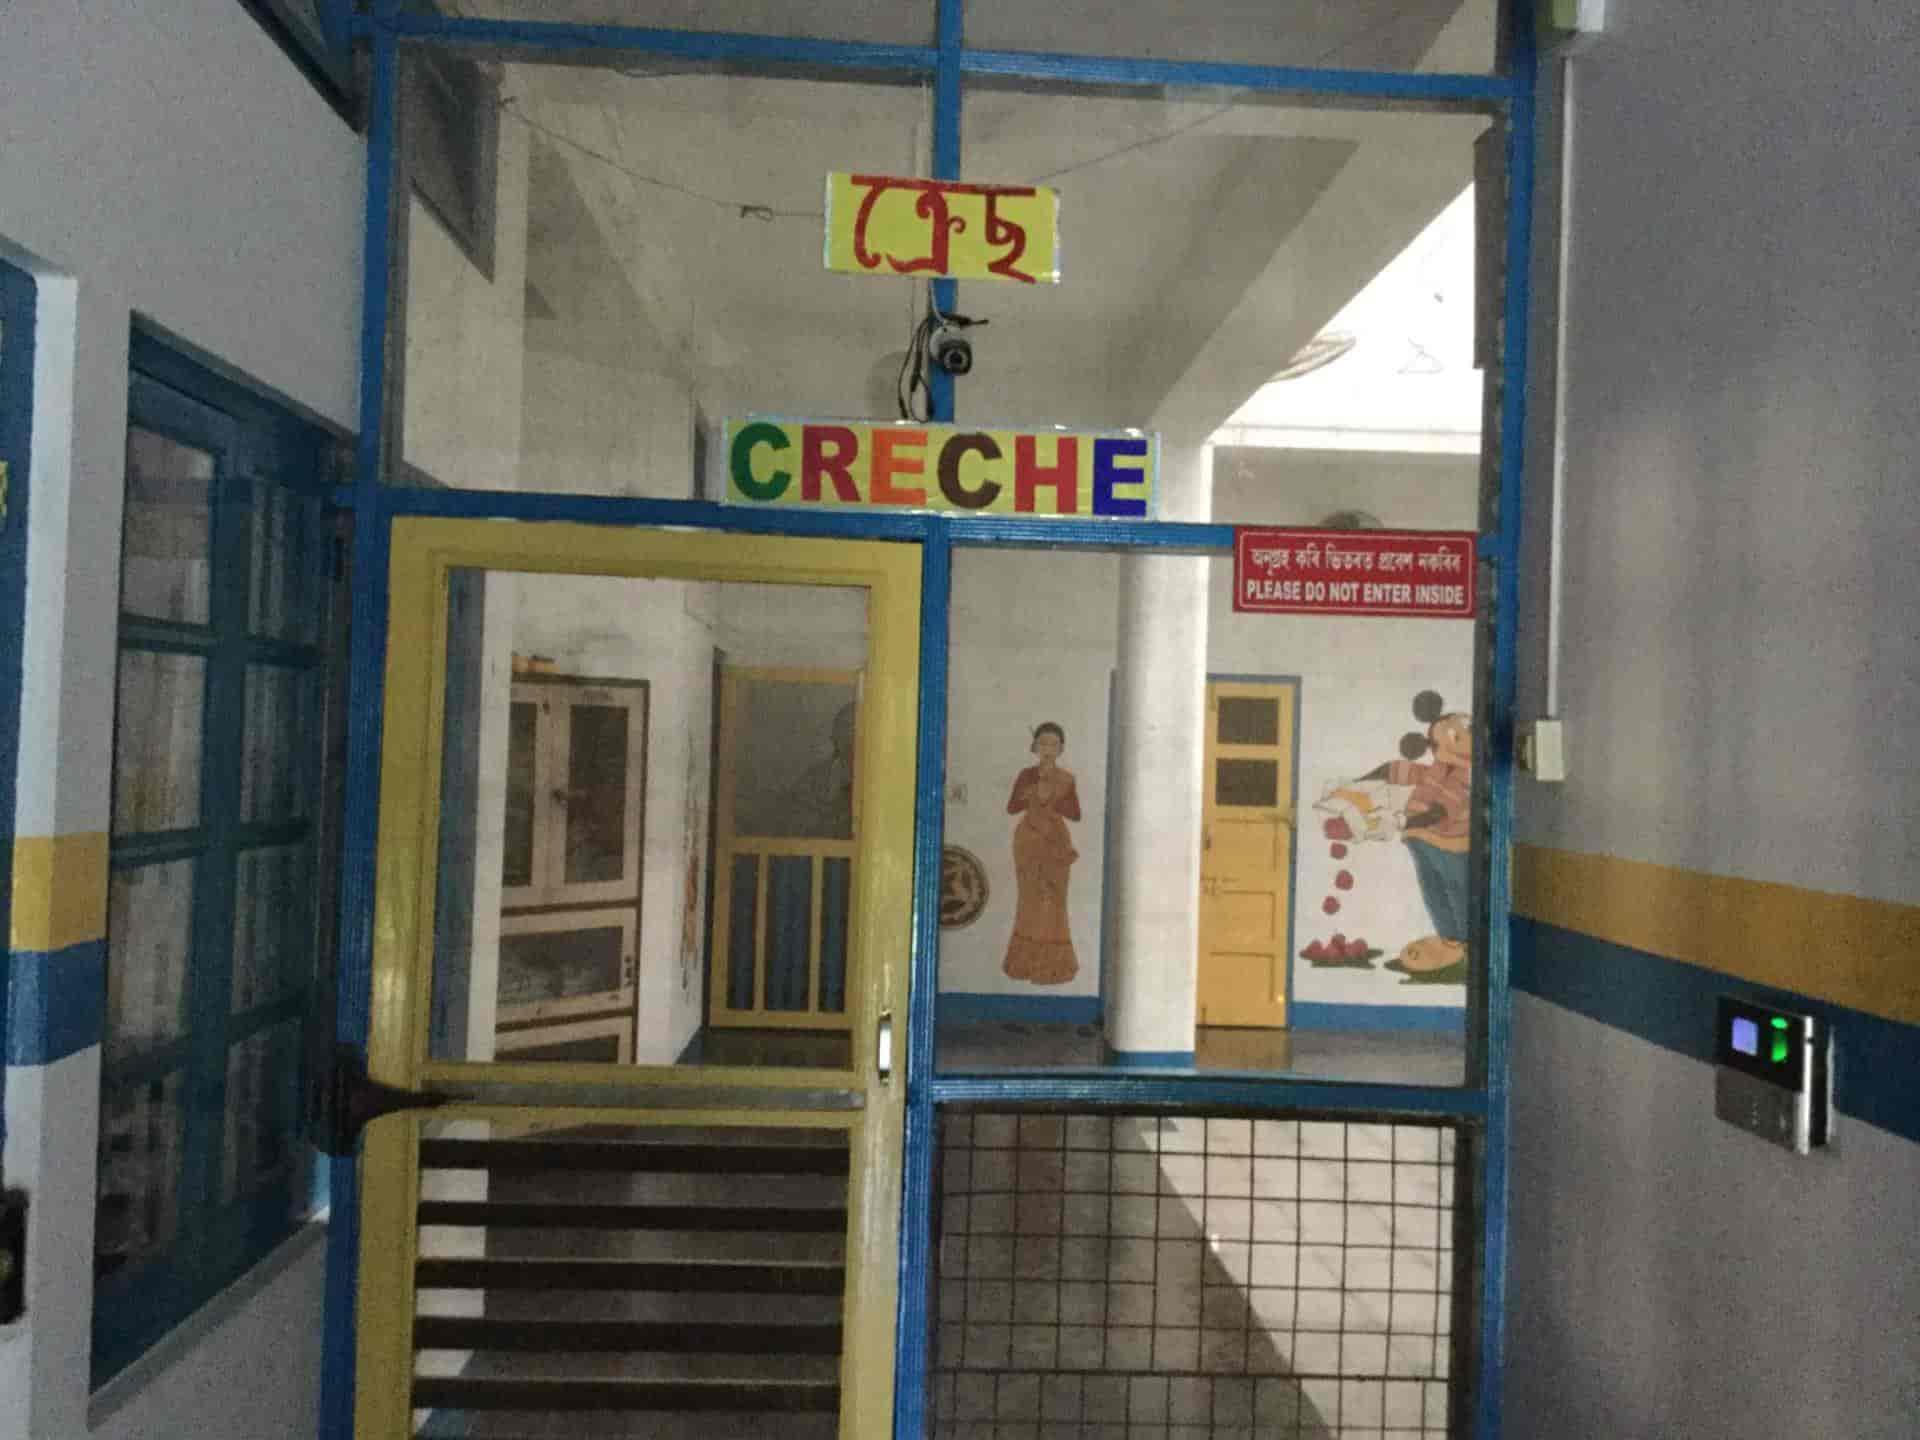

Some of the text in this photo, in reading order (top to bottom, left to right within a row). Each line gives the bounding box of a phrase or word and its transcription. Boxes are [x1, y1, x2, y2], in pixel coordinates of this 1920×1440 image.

[730, 423, 1148, 517] CRECHE
[1247, 579, 1464, 605] PLEASE DO NOT ENTER INSIDE
